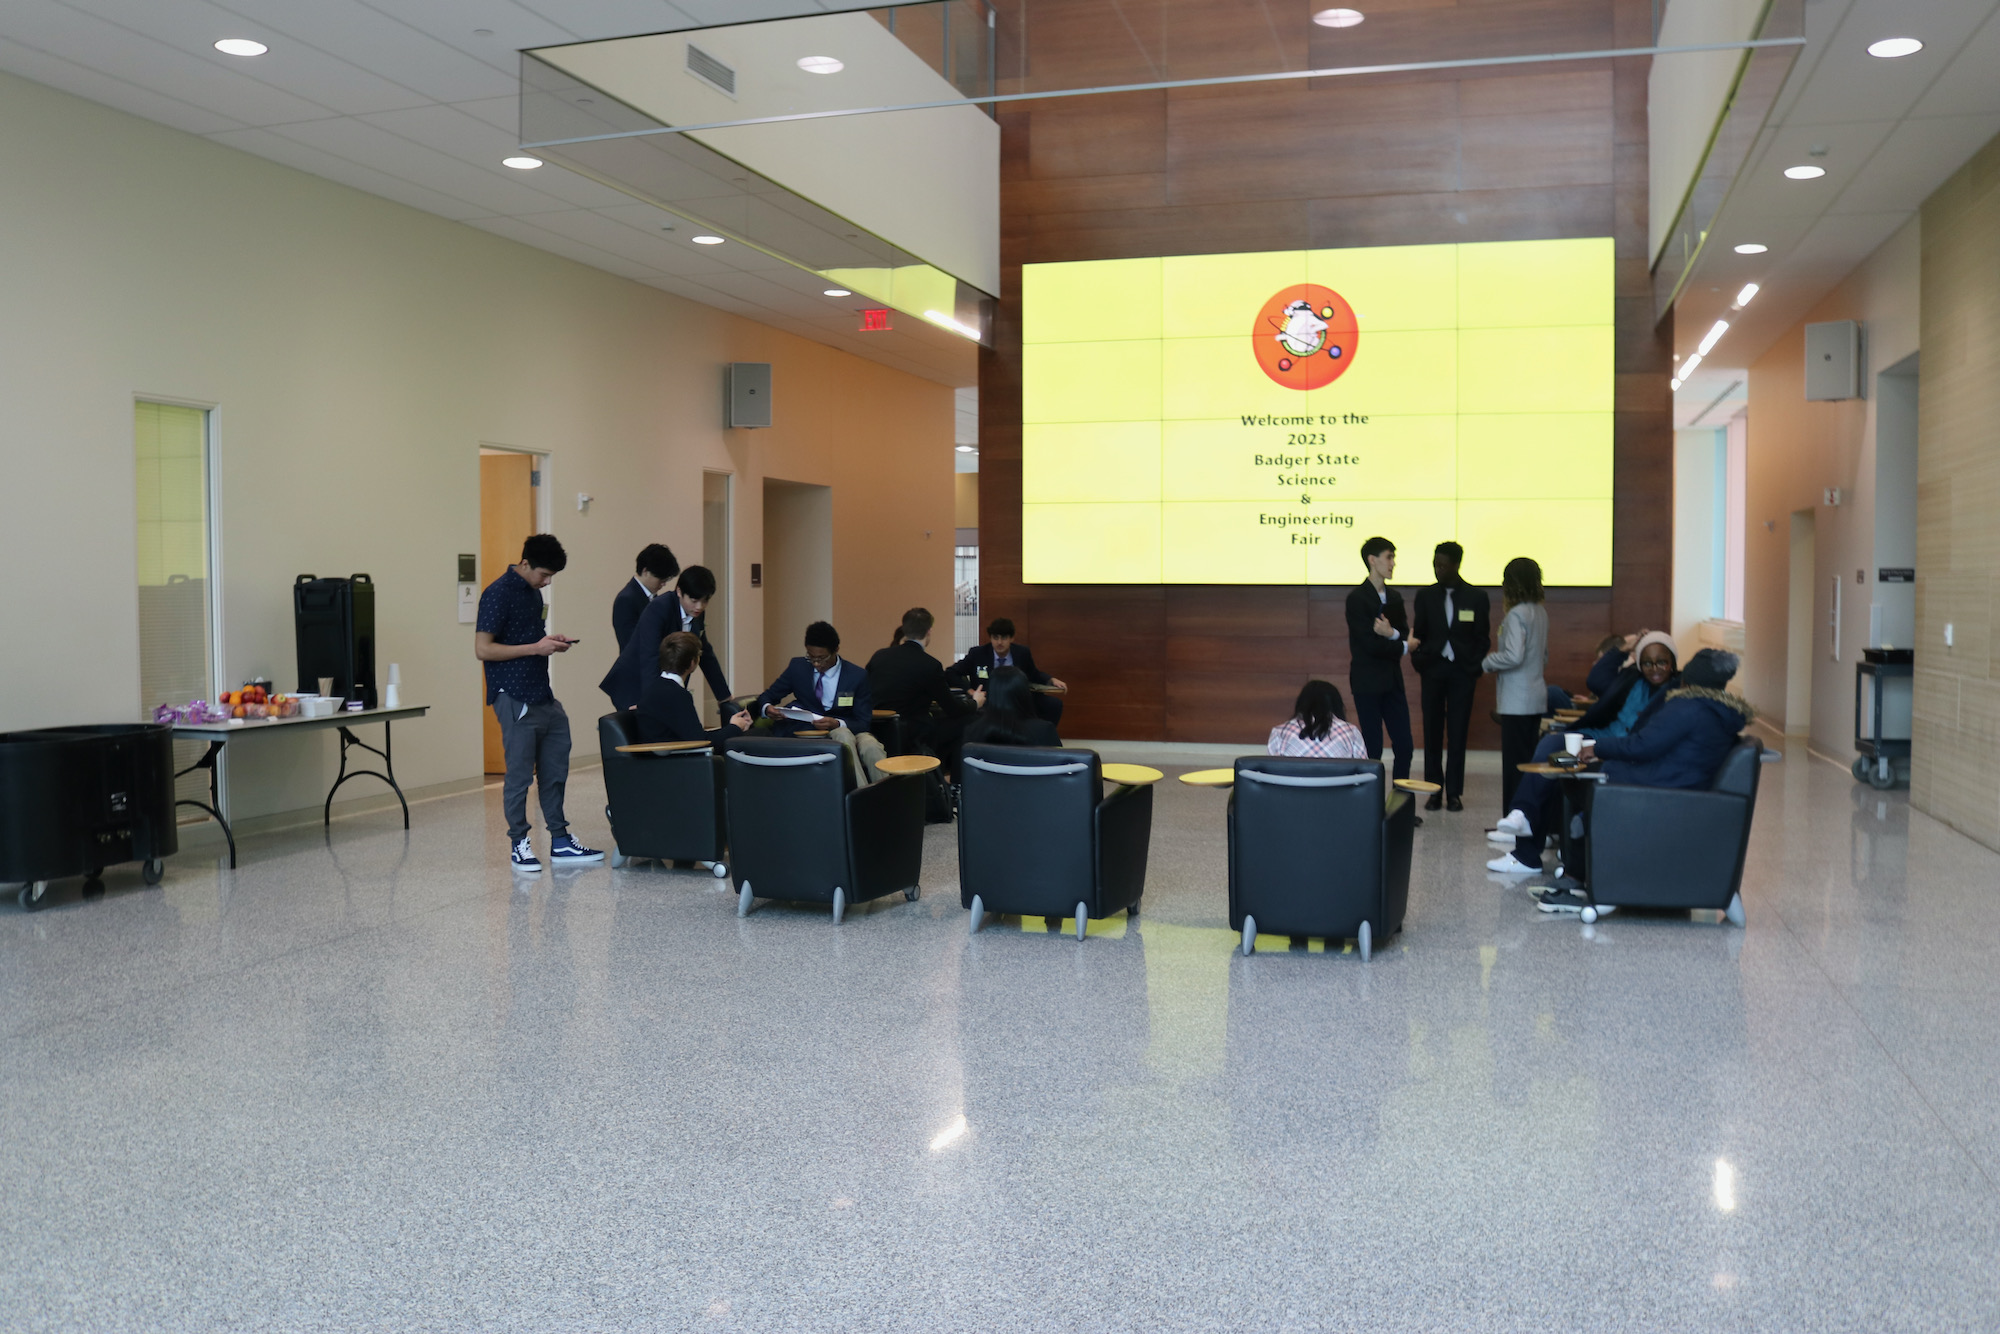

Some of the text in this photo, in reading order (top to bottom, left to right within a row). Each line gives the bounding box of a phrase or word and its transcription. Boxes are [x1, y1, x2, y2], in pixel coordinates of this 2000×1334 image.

[865, 310, 888, 329] EXIT
[1241, 413, 1369, 426] Welcome to the
[1287, 433, 1326, 445] 2023
[1254, 454, 1360, 469] Badger State
[1277, 474, 1336, 485] Science
[1300, 493, 1311, 504] &
[1259, 513, 1354, 528] Engineering
[1291, 533, 1321, 545] Fair
